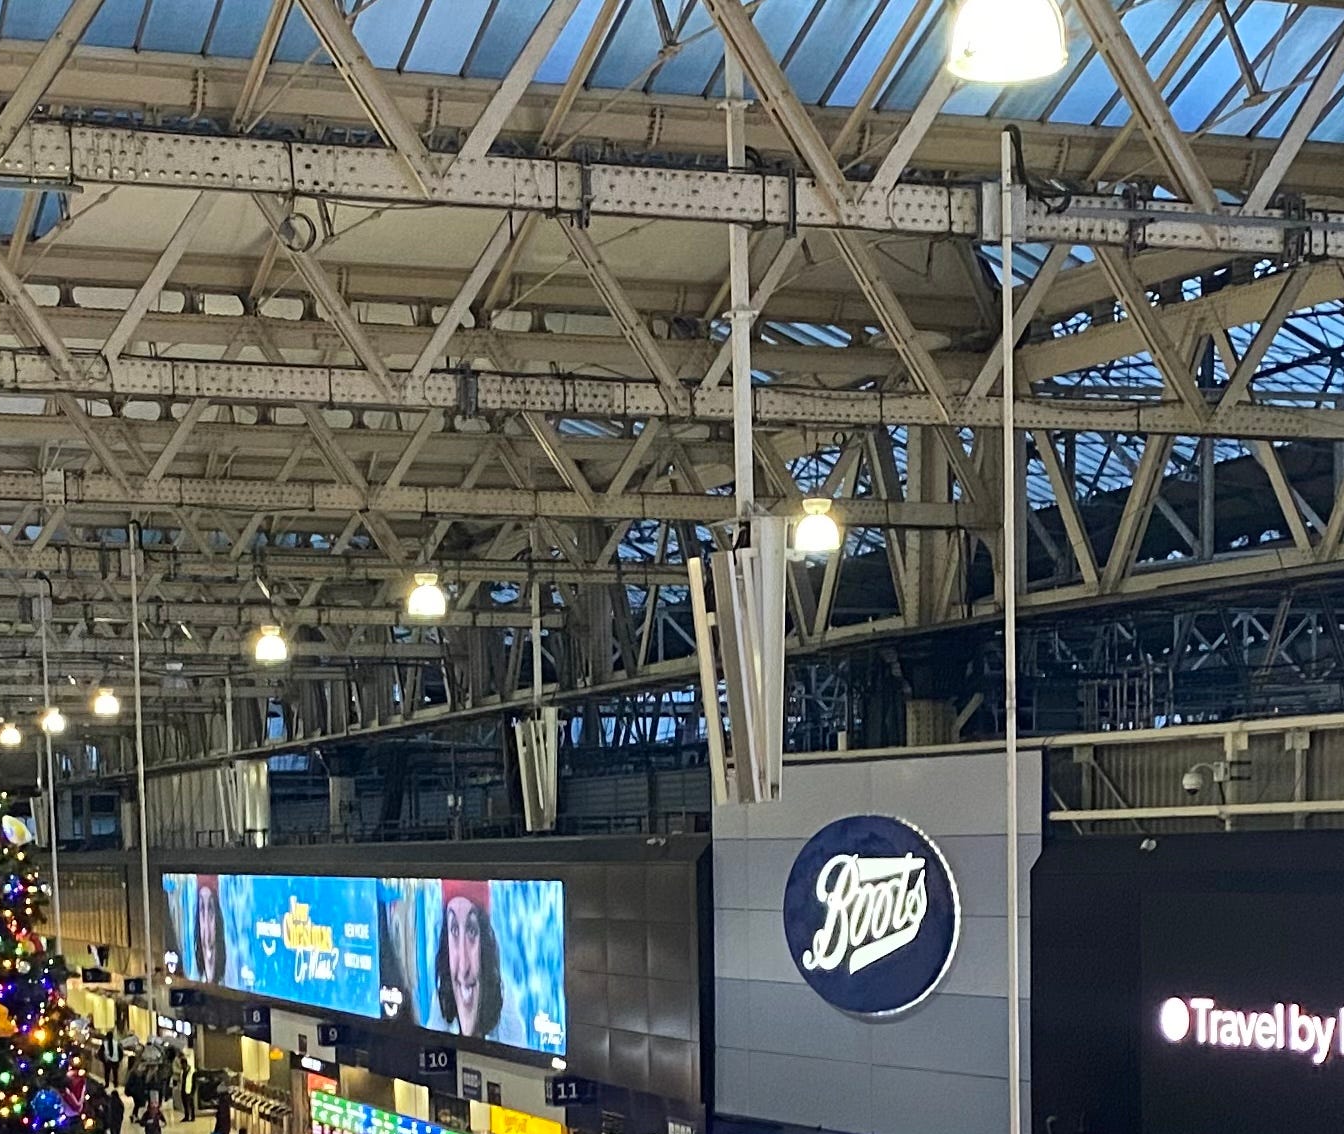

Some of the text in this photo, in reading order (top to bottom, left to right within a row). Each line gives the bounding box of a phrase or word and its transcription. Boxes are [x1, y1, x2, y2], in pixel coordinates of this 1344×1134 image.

[802, 852, 928, 975] Boots
[252, 1009, 261, 1023] 8
[328, 1027, 338, 1041] 9
[1191, 998, 1285, 1050] Travel
[1288, 1002, 1337, 1065] by
[428, 1052, 448, 1068] 10
[556, 1082, 578, 1098] 11
